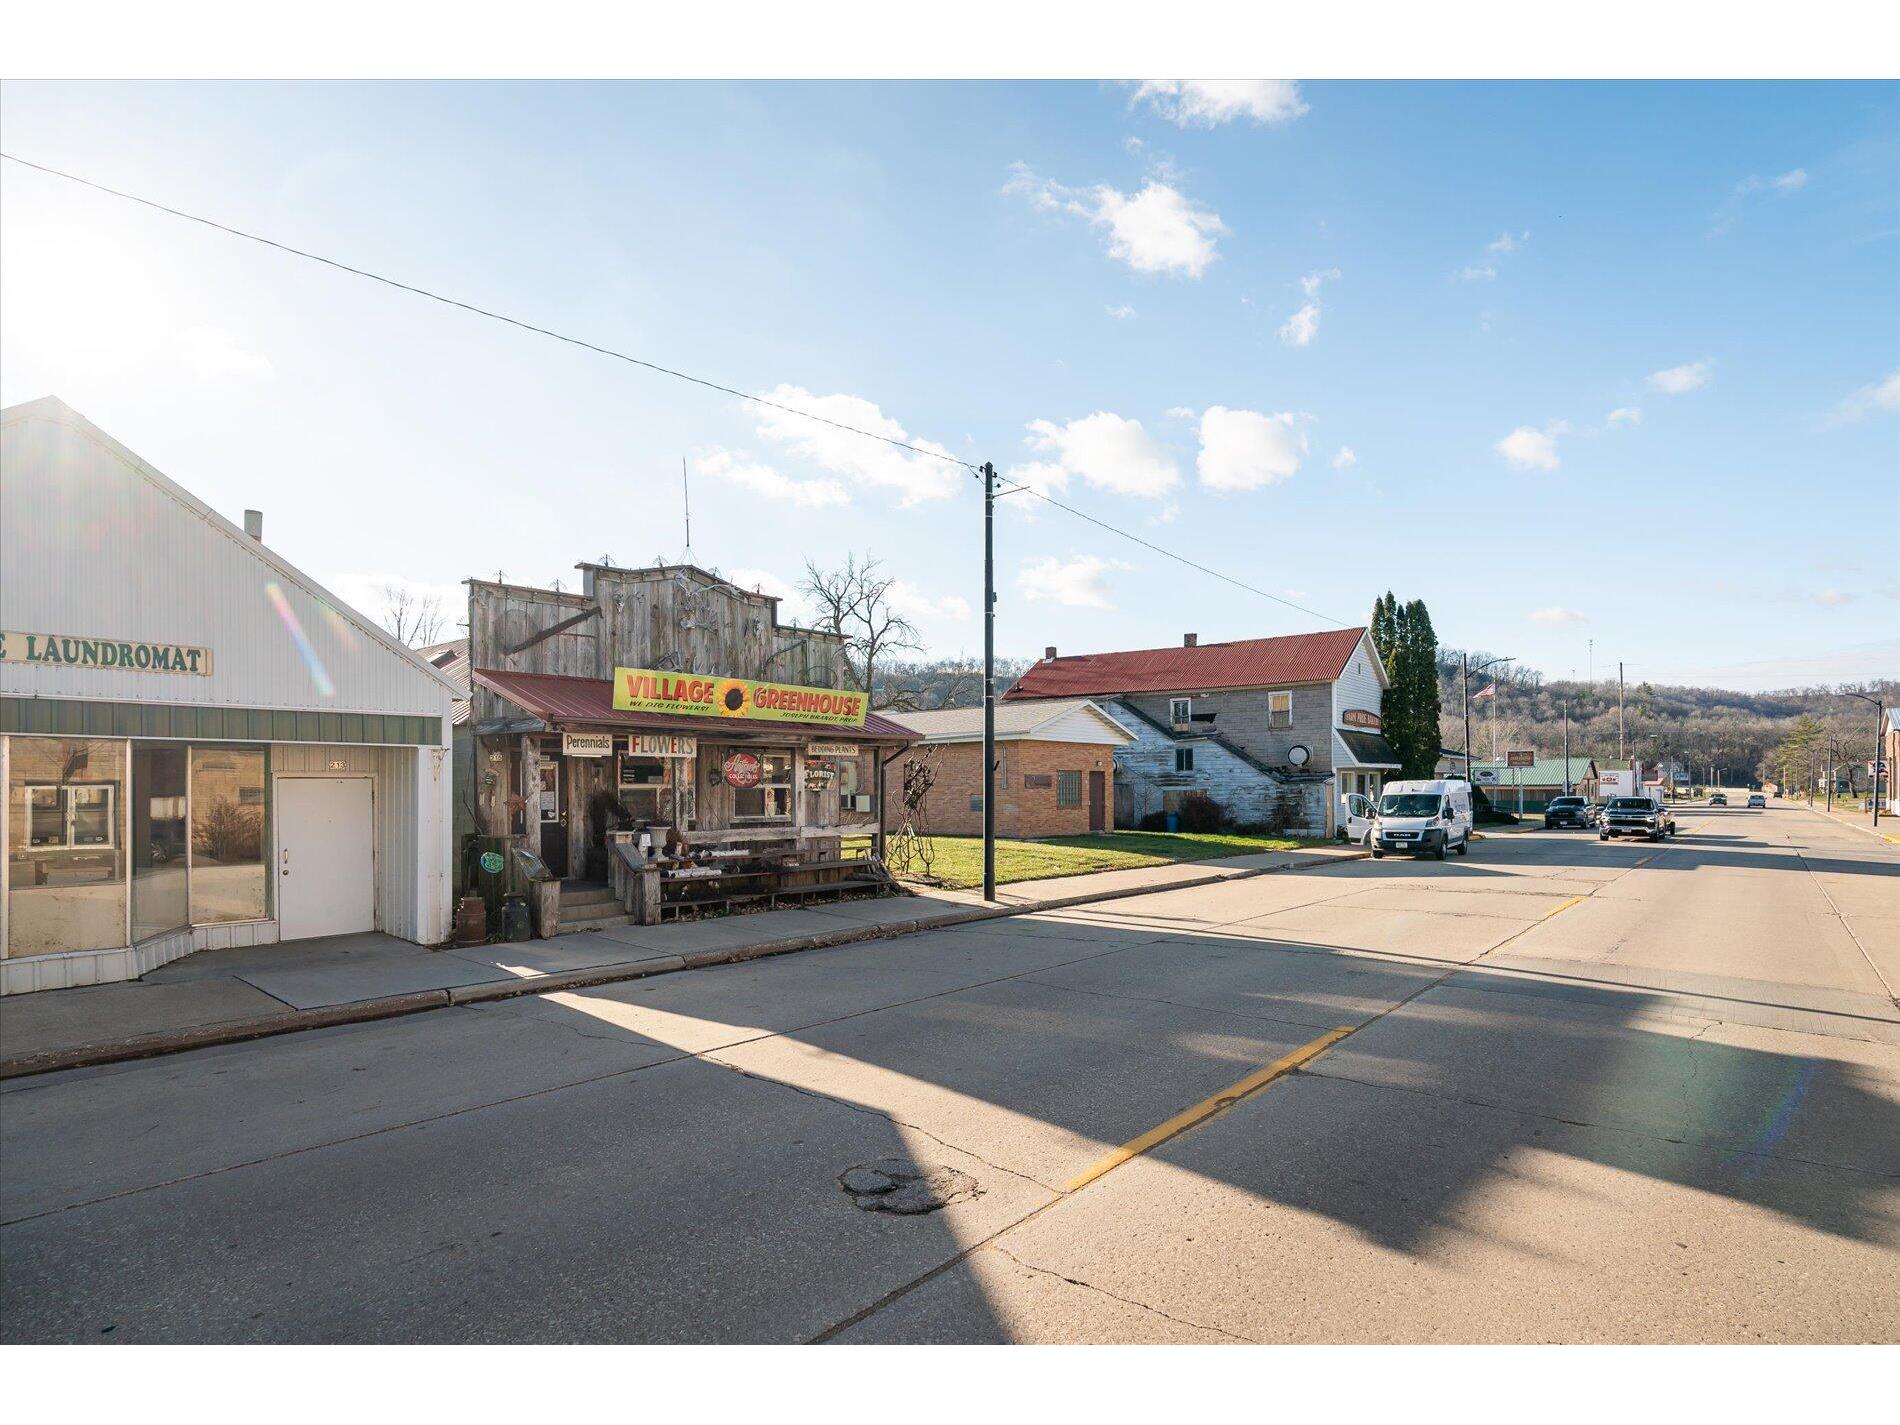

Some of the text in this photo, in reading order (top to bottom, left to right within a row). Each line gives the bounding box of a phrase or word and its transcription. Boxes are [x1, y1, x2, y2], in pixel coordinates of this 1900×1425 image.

[26, 635, 201, 672] LAUNDROMAT
[626, 674, 862, 717] VILLAGE GREENHOUSE
[566, 734, 610, 750] Perennials
[632, 735, 695, 755] FLOWERS
[834, 744, 857, 754] PLANTS
[804, 769, 835, 780] FLORIST
